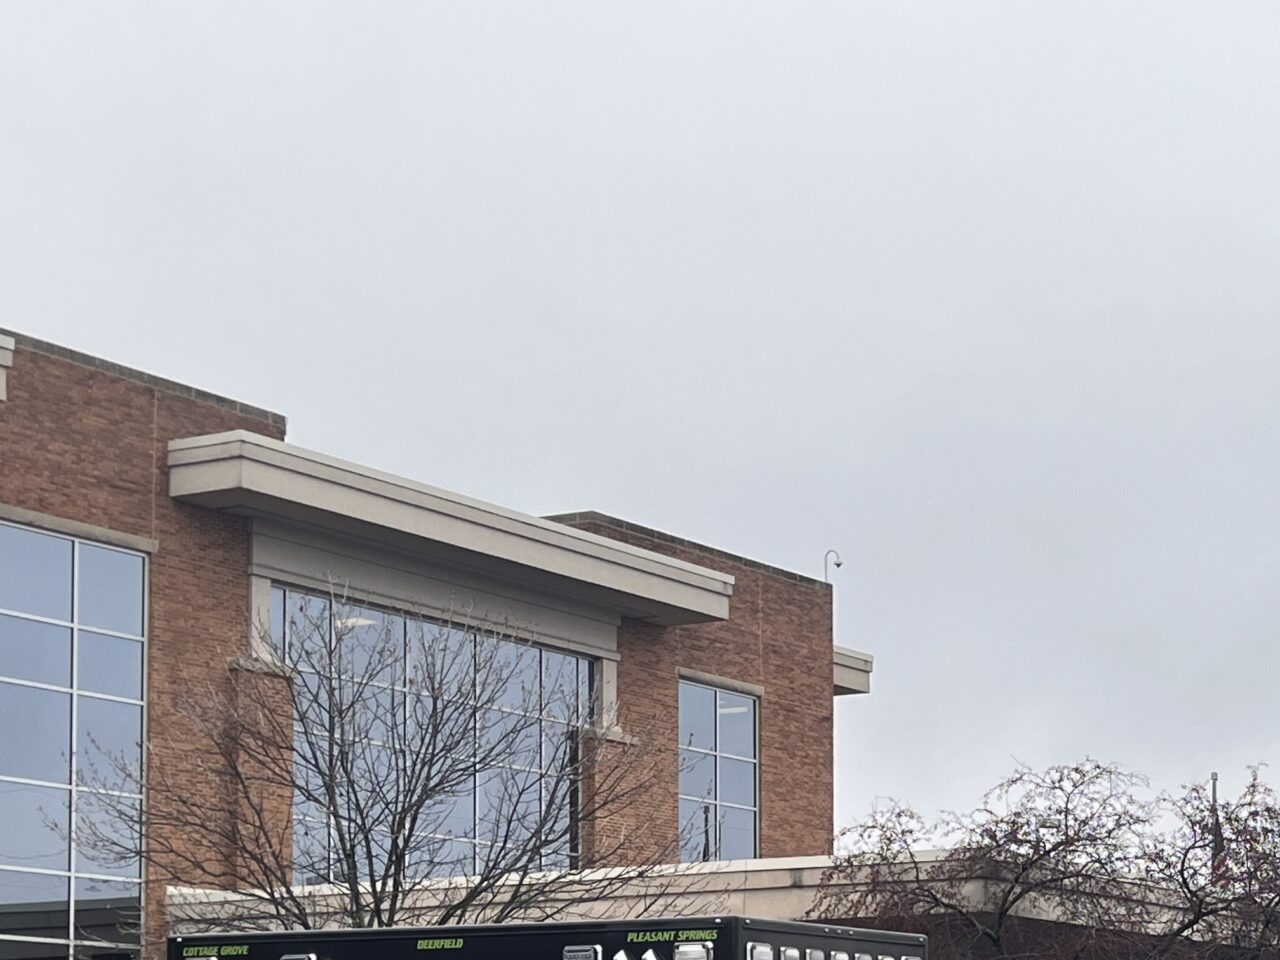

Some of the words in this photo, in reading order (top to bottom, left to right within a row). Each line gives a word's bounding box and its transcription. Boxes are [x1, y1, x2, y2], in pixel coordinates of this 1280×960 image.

[627, 931, 675, 942] PLEASANT
[677, 929, 718, 940] SPRINGS
[417, 938, 464, 950] DEERFIELD
[182, 946, 219, 957] COTTAGE
[220, 945, 249, 956] GROVE
